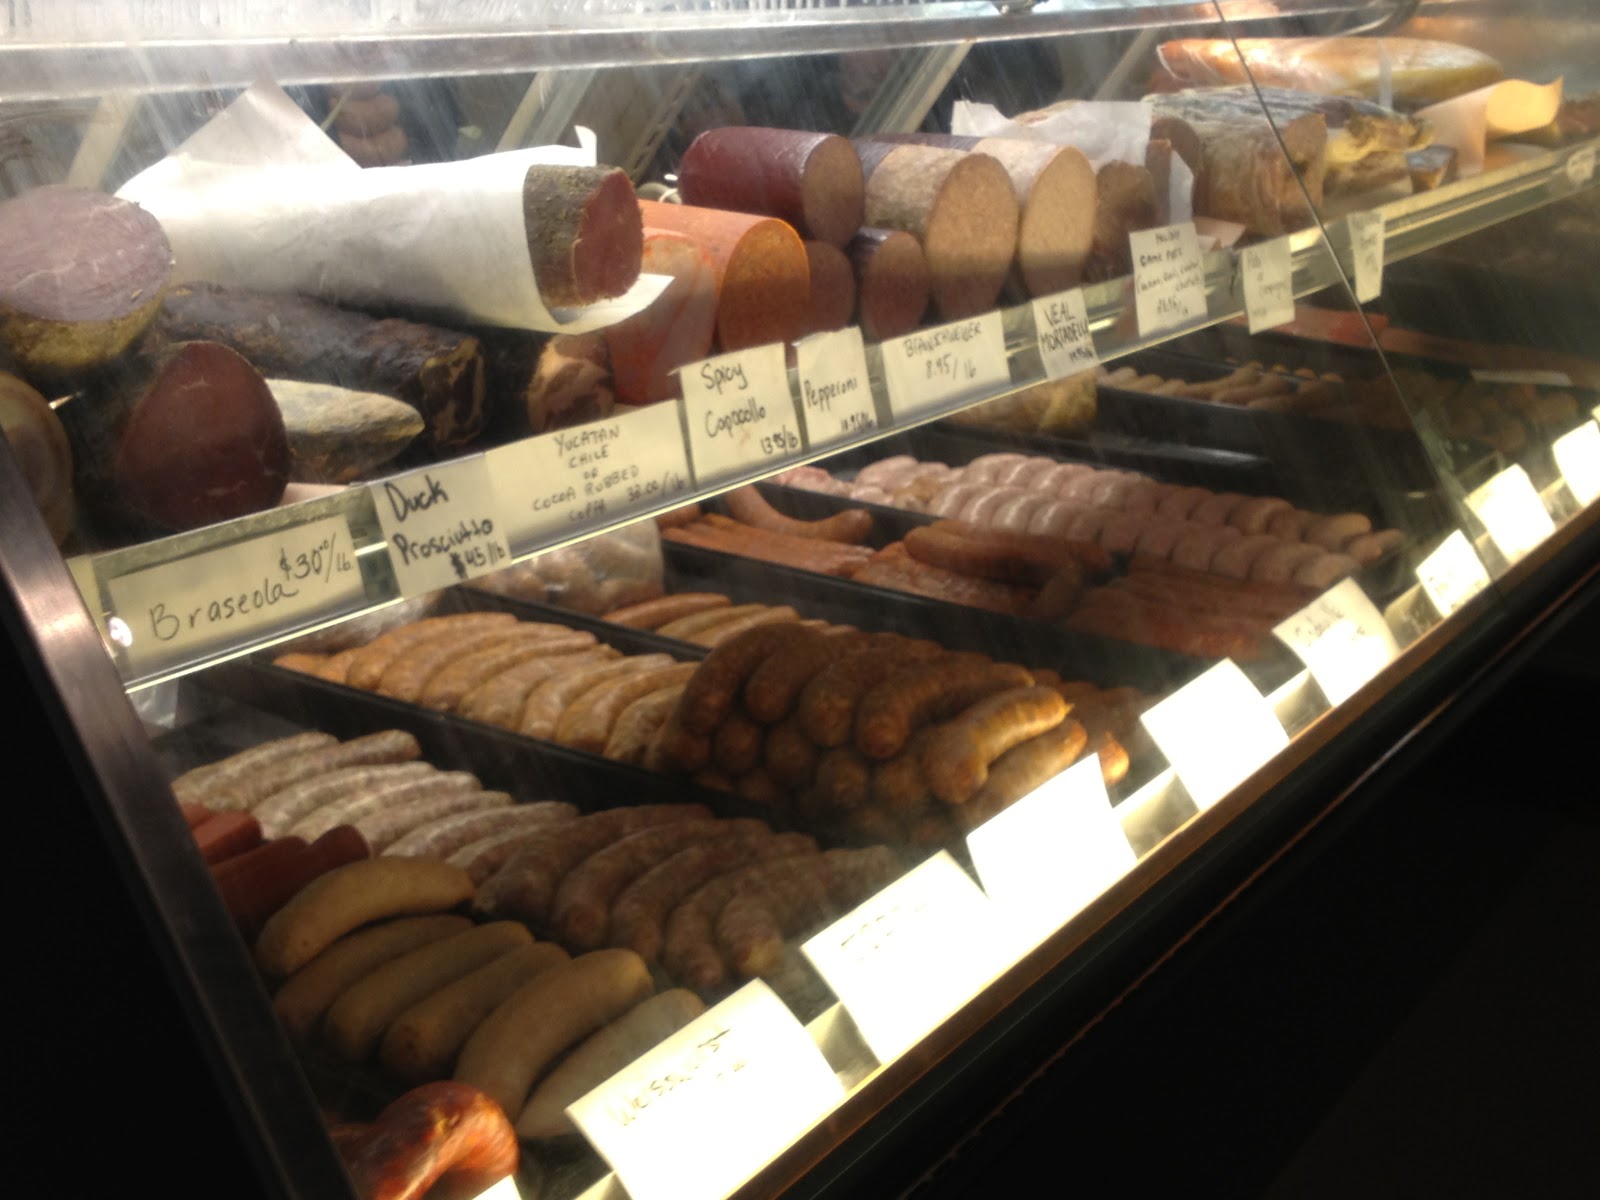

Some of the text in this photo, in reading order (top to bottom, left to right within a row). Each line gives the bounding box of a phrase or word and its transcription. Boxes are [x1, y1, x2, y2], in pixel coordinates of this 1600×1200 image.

[701, 362, 749, 396] Spicy
[553, 425, 620, 459] YUCATAN
[568, 444, 610, 469] CHILE
[584, 464, 640, 497] RUBBED
[383, 473, 450, 523] Duck
[392, 518, 494, 566] Prosciutto
[149, 577, 299, 641] Braseola
